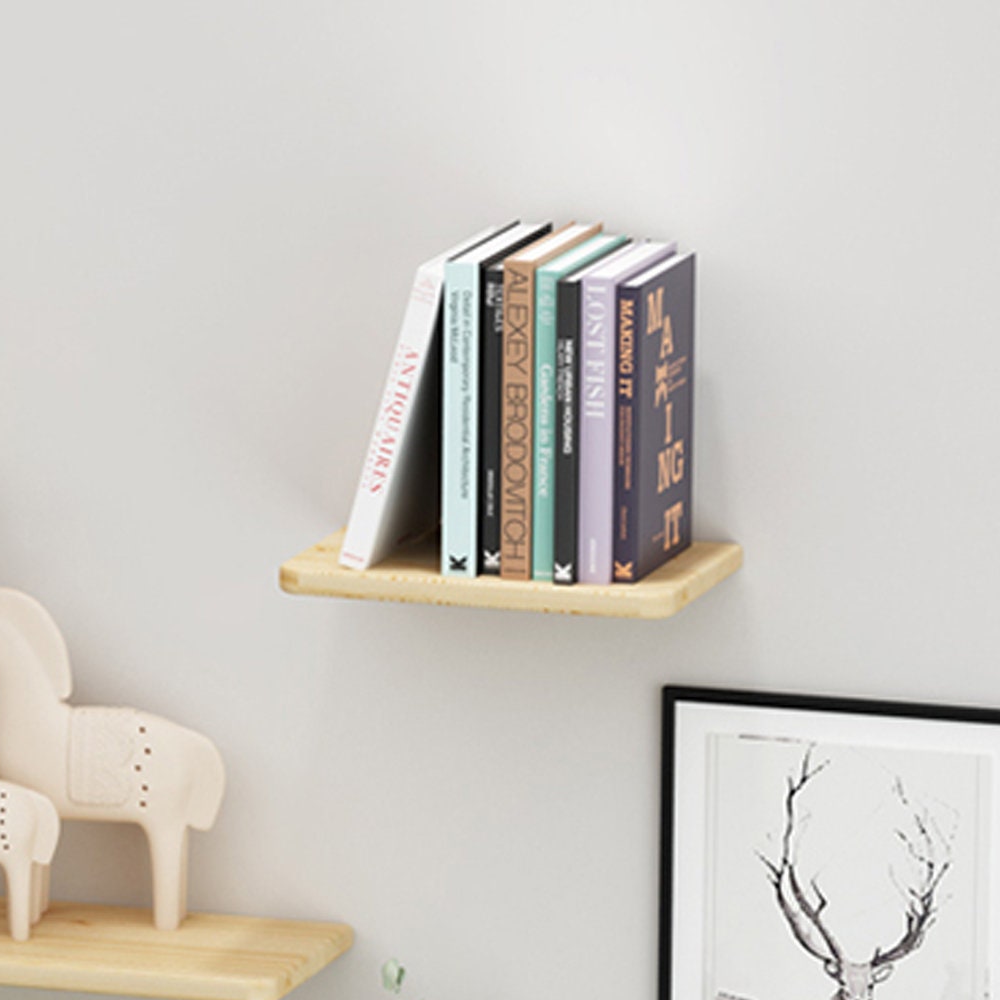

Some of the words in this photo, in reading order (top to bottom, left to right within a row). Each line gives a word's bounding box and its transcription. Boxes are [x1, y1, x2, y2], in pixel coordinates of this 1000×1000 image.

[506, 267, 529, 375] ALEXEY
[585, 284, 607, 354] LOST
[619, 298, 635, 375] MAKING
[564, 339, 574, 364] NEW
[539, 363, 553, 426] Gardens
[563, 366, 573, 402] URBAN
[584, 359, 606, 419] FISH
[618, 377, 634, 399] IT
[539, 428, 552, 445] in
[562, 405, 573, 455] HOUSING
[504, 382, 529, 560] BRODOVITCH
[538, 447, 552, 498] France
